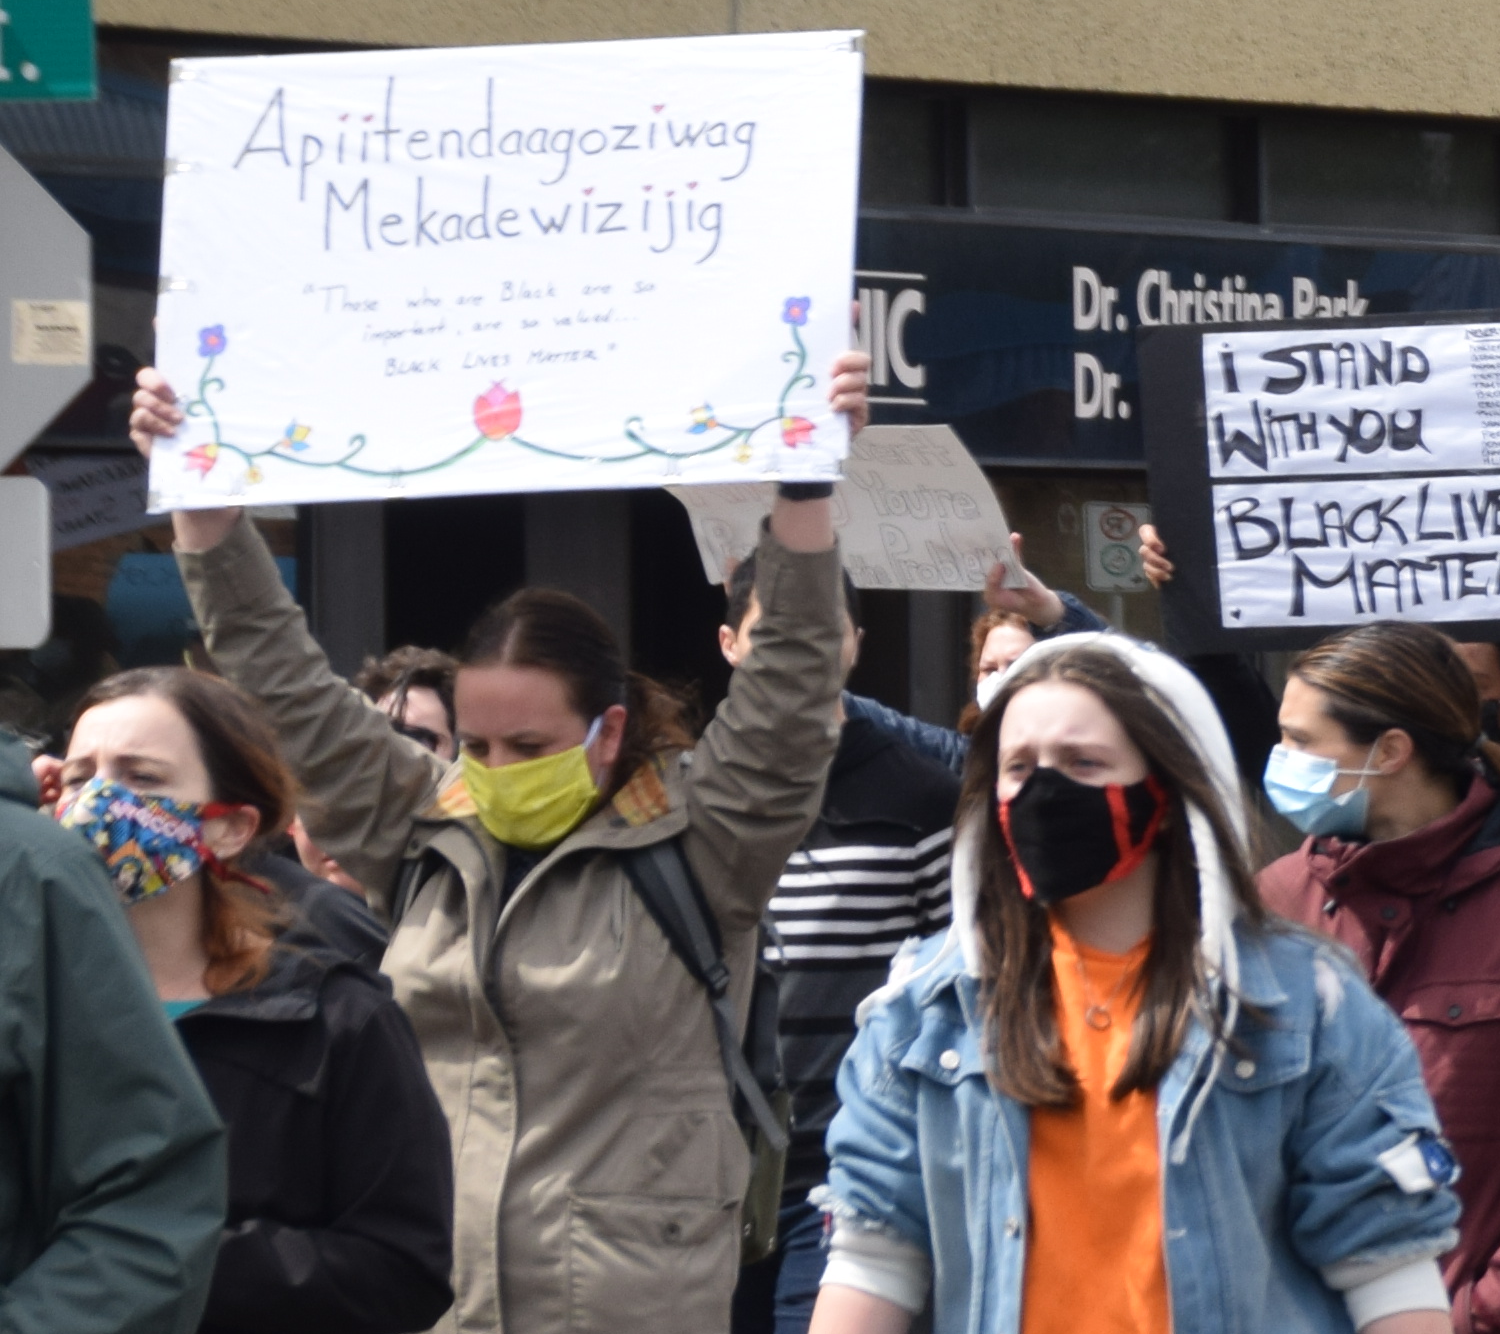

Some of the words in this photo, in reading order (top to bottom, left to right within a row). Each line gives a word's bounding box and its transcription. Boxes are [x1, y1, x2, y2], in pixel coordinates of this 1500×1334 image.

[234, 76, 757, 201] Apiitendaagoziwag
[324, 175, 722, 264] Mekadewizijig
[1073, 267, 1129, 331] Dr.
[1137, 269, 1284, 326] Christina
[1292, 276, 1369, 319] Park
[1074, 352, 1131, 418] Dr.
[1260, 339, 1430, 395] STAND
[1327, 408, 1431, 462] YOU
[1219, 496, 1408, 560] BLACK
